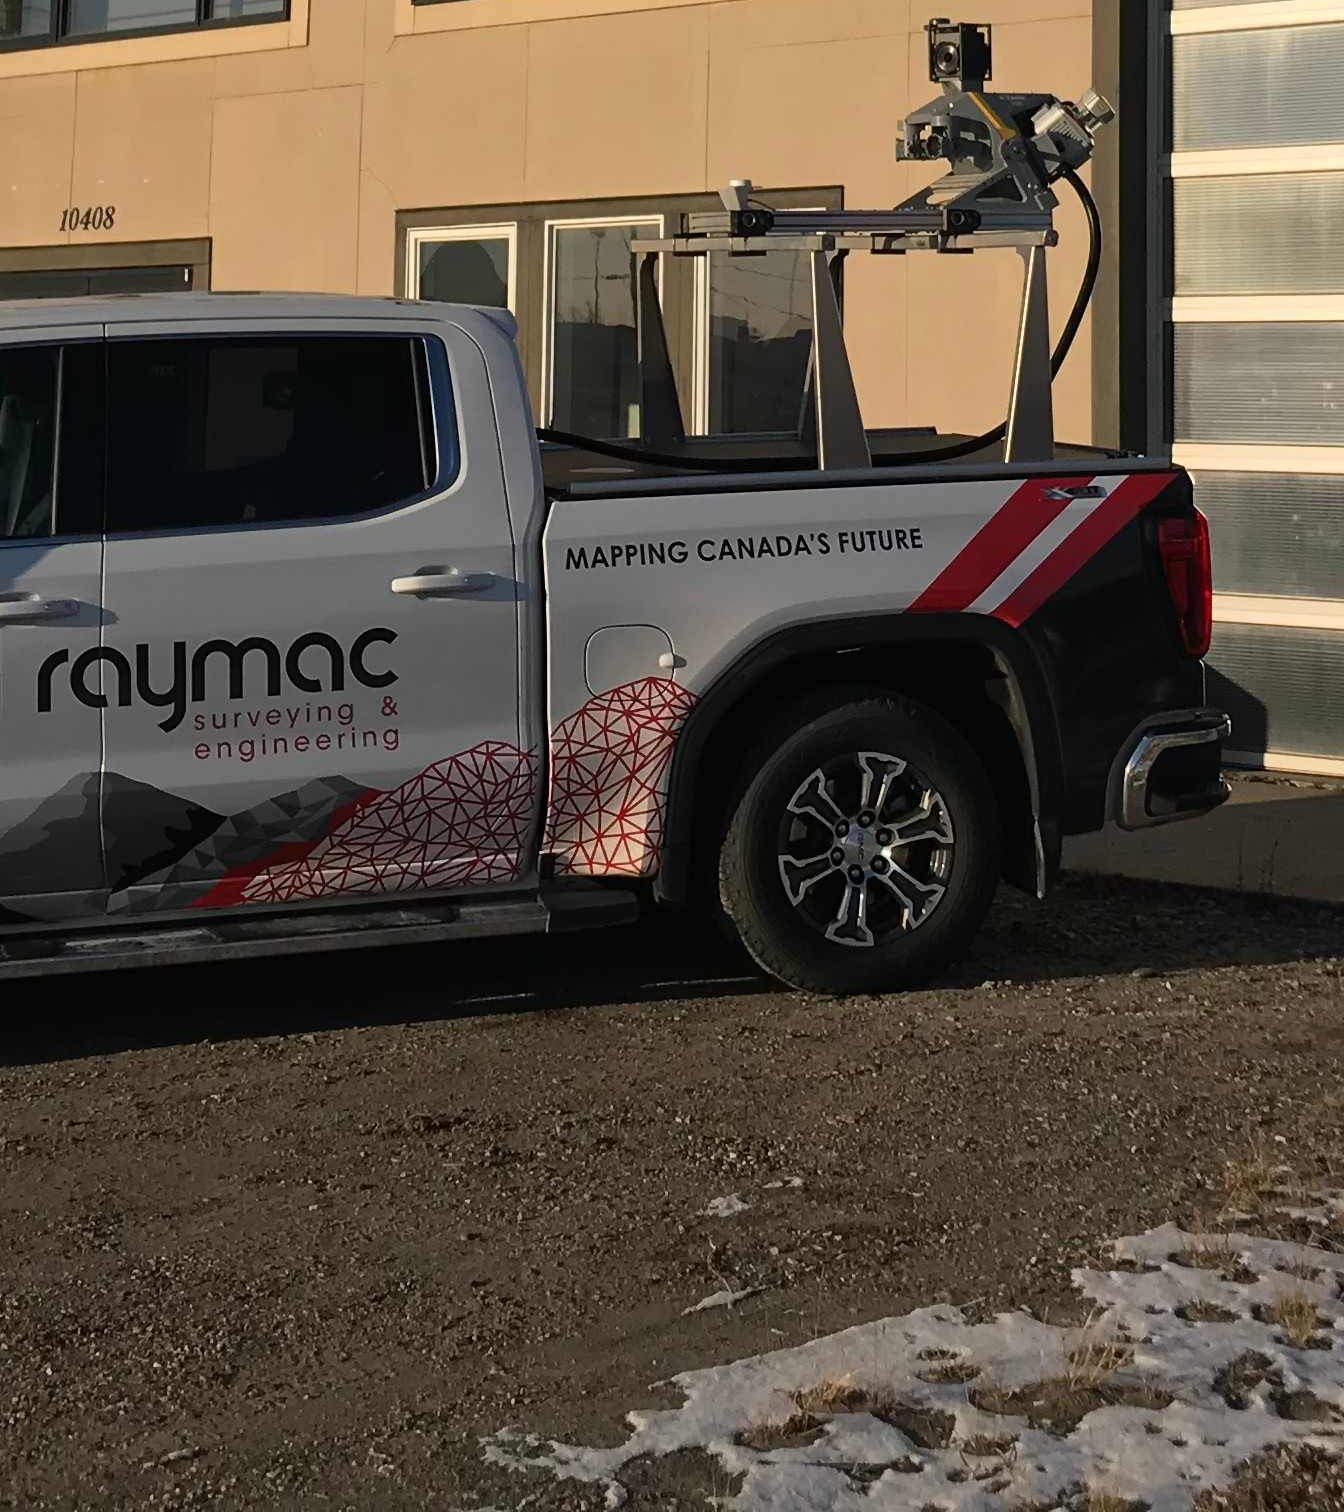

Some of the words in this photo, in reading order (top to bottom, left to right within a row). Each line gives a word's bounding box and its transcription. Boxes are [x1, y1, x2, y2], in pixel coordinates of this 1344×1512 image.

[59, 206, 116, 231] 10408
[565, 541, 689, 570] MAPPING
[697, 532, 831, 562] CANADA'S
[838, 528, 923, 553] FUTURE
[37, 627, 399, 733] raymac
[194, 702, 354, 731] surveying
[381, 695, 399, 717] &
[194, 727, 399, 763] engineering
